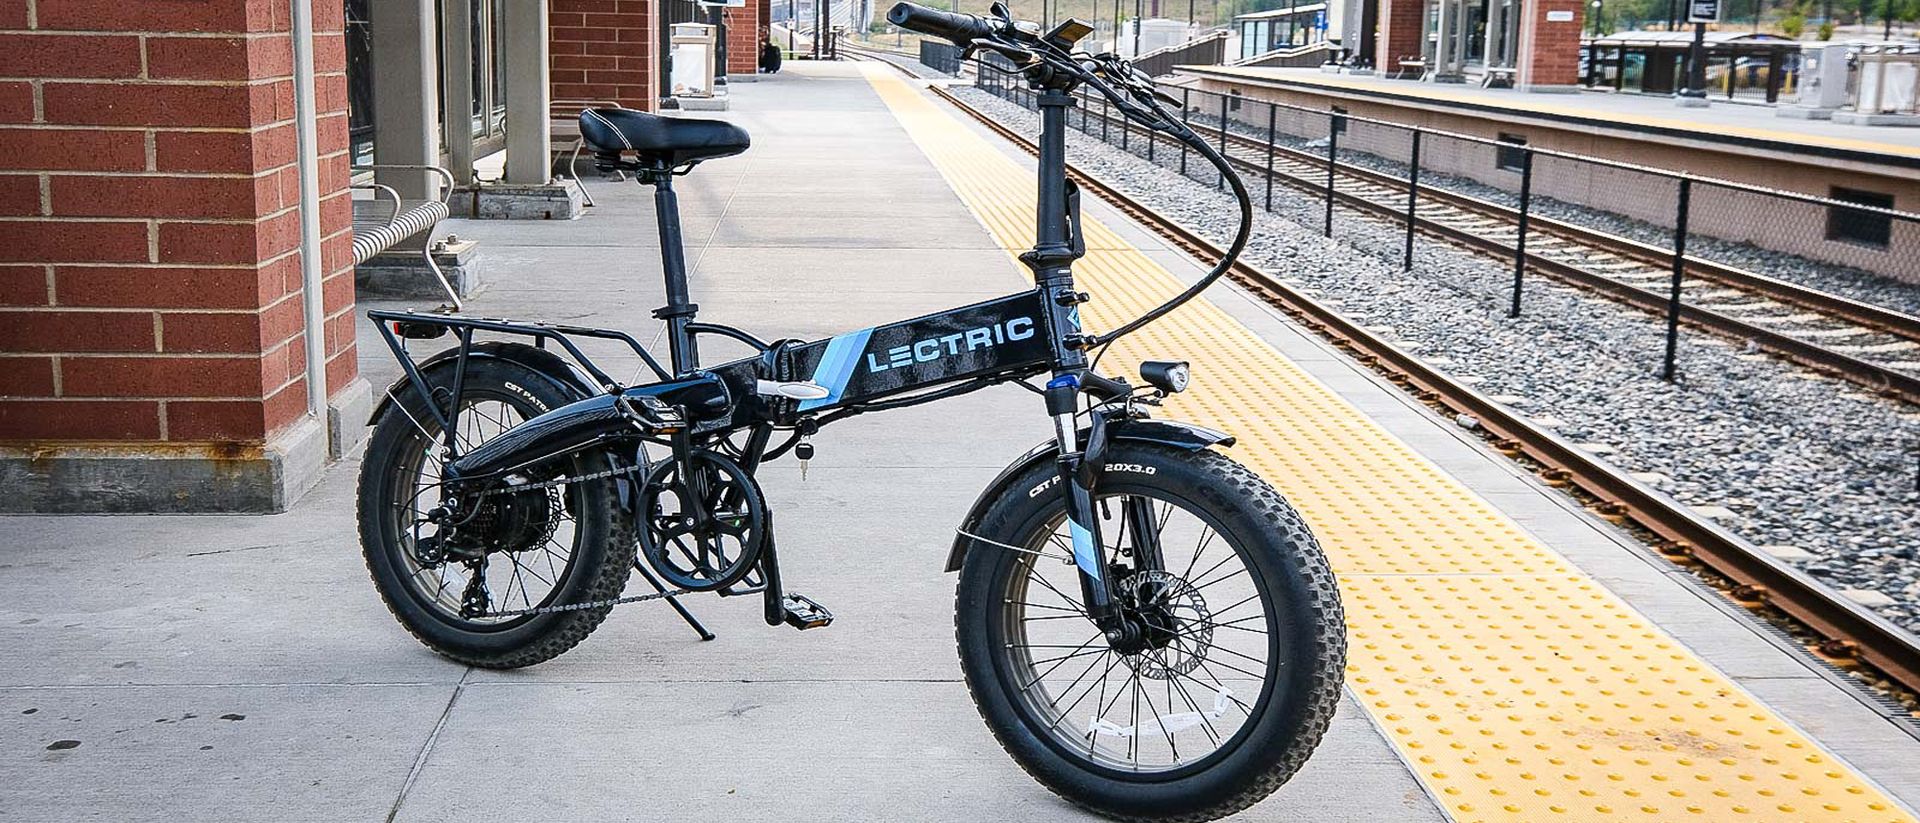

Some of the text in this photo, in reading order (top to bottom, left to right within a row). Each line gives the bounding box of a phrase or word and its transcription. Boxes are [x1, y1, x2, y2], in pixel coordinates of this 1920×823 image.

[867, 316, 1035, 373] LECTRIC
[504, 381, 524, 393] CST
[1028, 479, 1052, 498] CST
